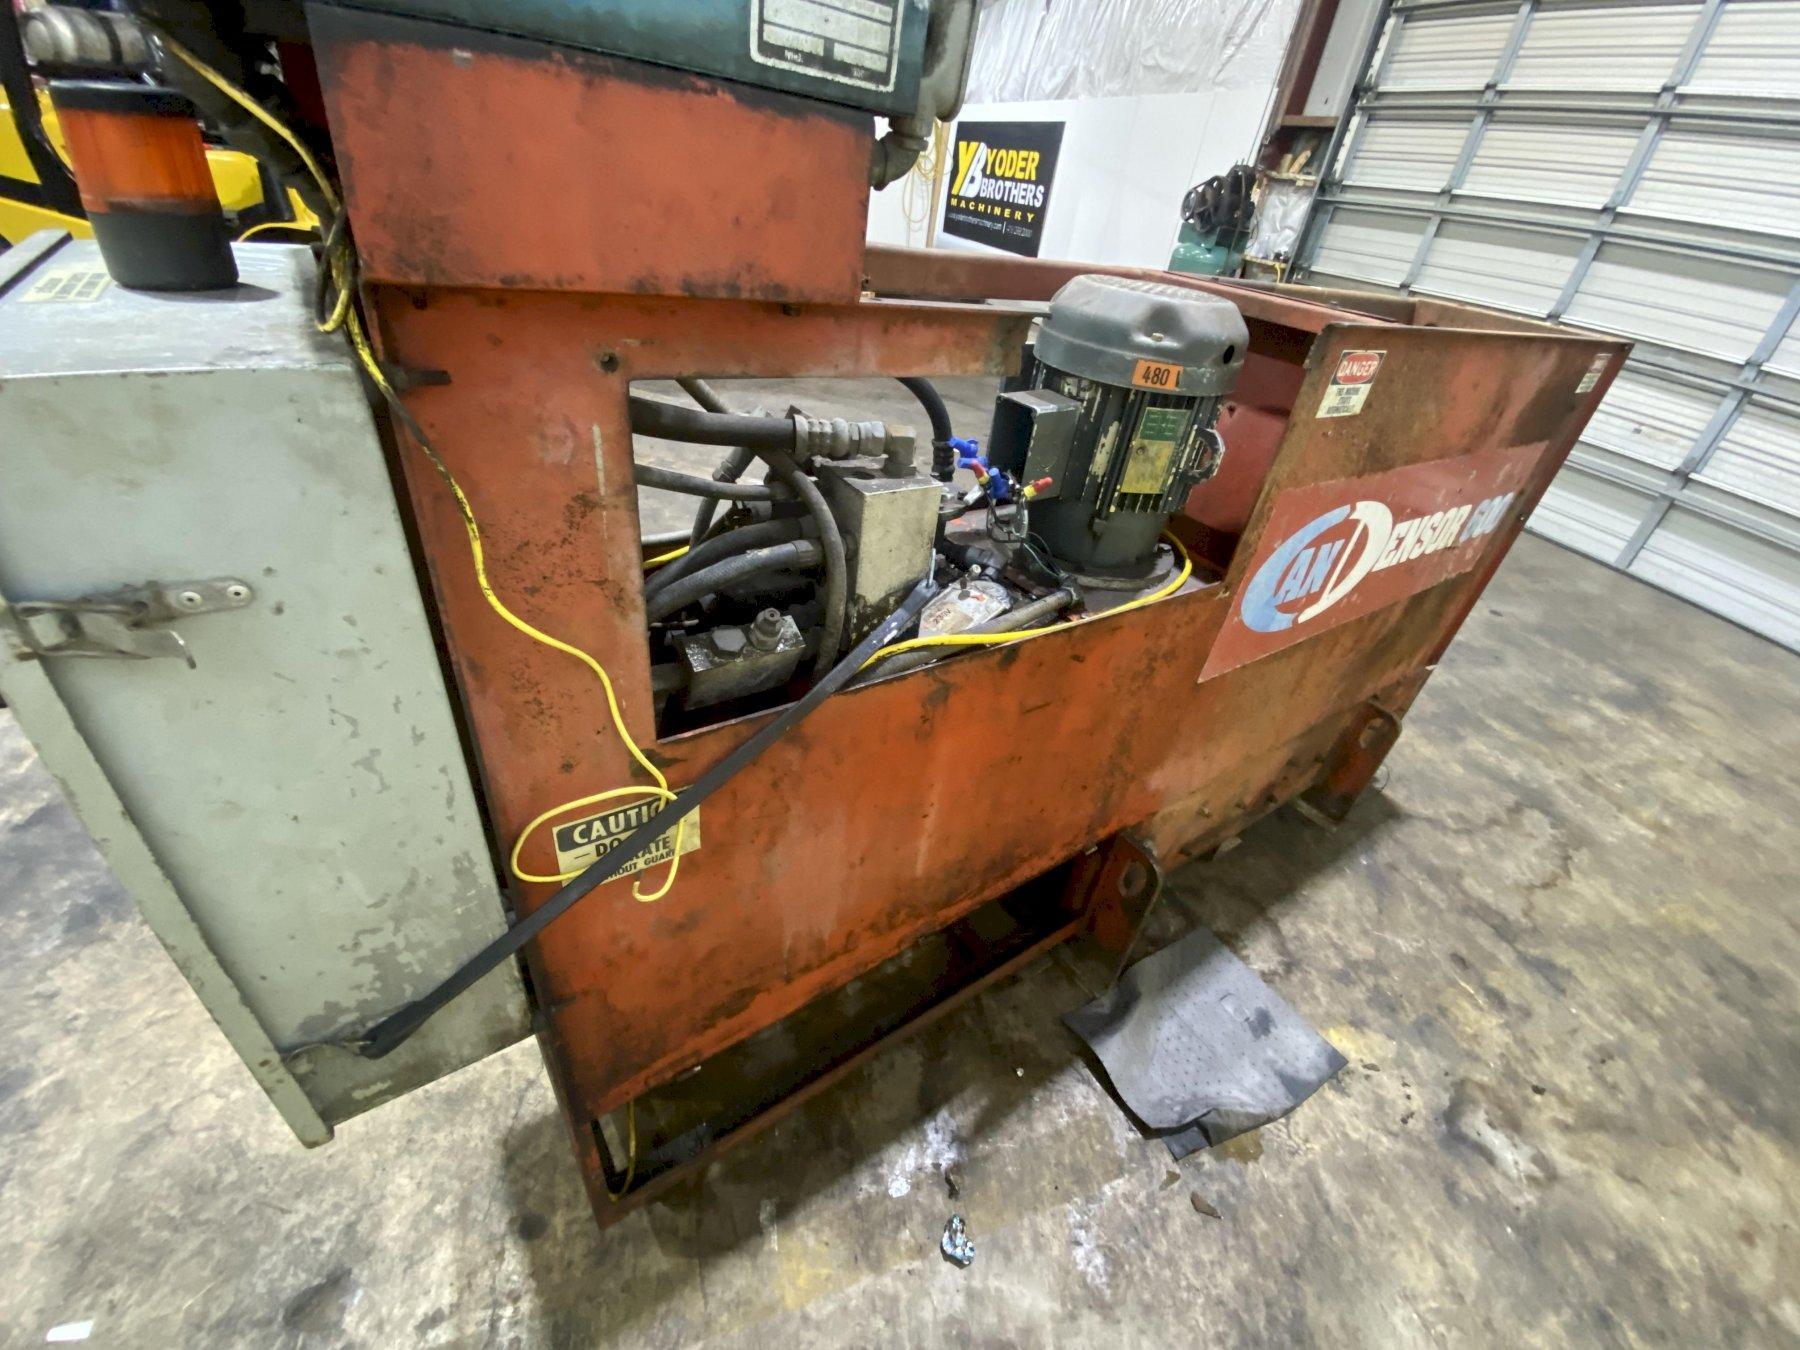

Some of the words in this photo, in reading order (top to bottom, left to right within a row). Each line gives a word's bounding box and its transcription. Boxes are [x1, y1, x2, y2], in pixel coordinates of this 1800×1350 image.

[985, 148, 1039, 180] YODER
[980, 178, 1044, 207] BROTHERS
[950, 198, 1034, 222] MACHINERY
[1142, 365, 1171, 386] 480
[1337, 360, 1379, 376] DANGER
